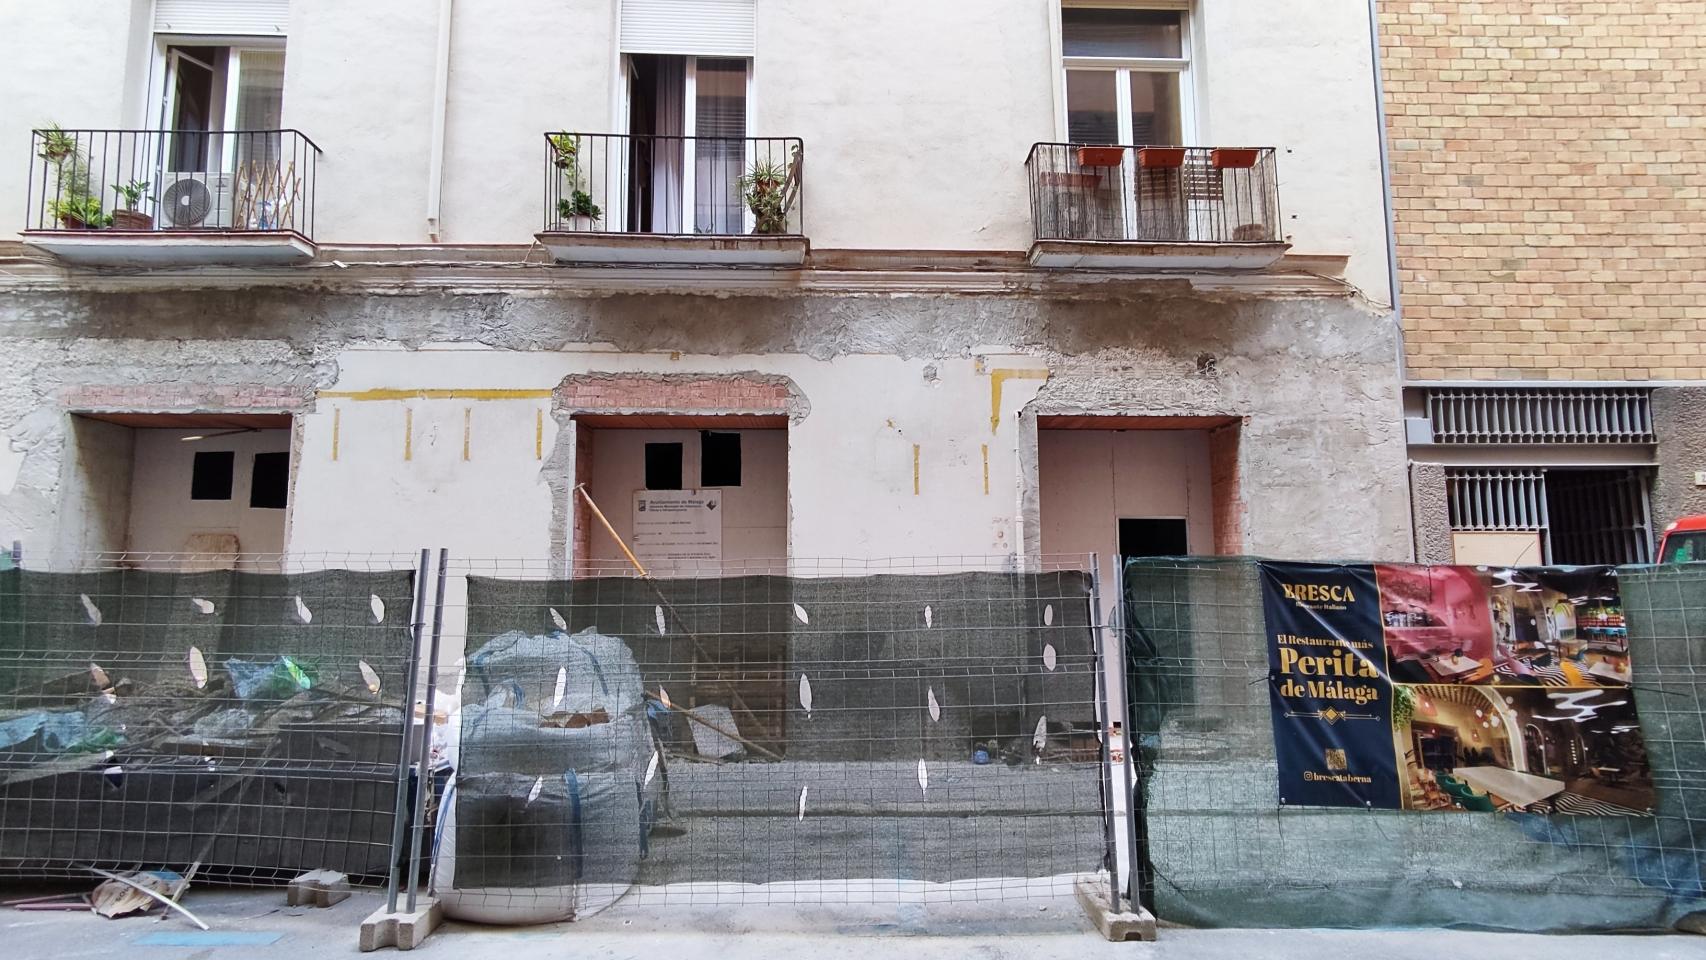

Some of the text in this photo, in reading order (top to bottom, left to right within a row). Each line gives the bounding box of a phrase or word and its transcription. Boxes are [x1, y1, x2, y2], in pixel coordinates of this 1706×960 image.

[1282, 584, 1355, 602] BRESCA
[1277, 635, 1287, 644] El
[1351, 640, 1374, 649] más
[1279, 647, 1380, 678] Perita
[1280, 679, 1378, 705] de Málaga
